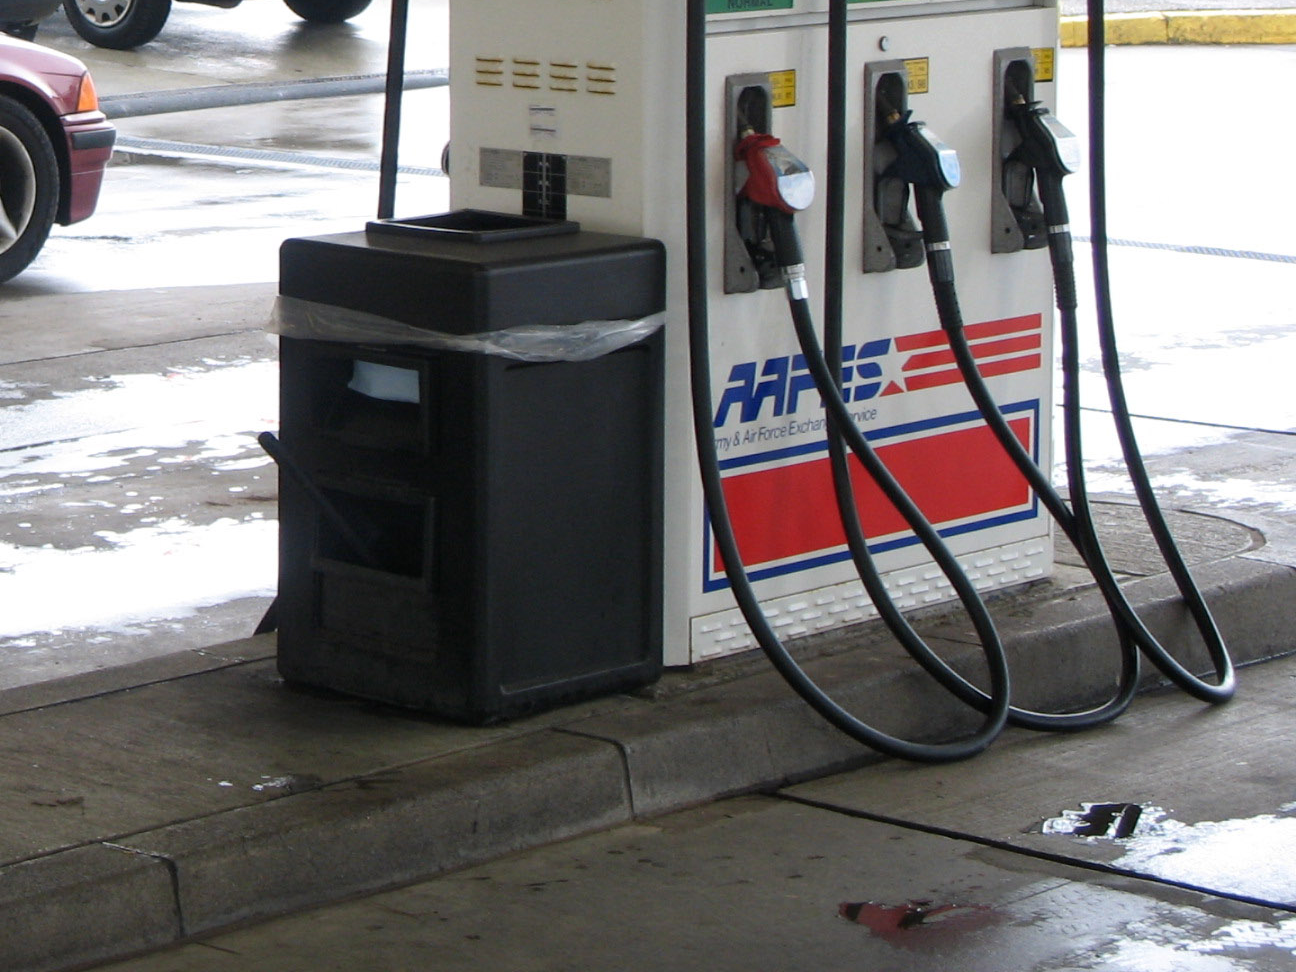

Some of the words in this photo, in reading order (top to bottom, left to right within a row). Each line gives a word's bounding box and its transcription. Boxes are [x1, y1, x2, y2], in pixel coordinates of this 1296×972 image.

[713, 337, 892, 428] AAFES
[715, 436, 733, 452] rmy
[733, 431, 741, 447] &
[742, 429, 757, 446] Air
[757, 424, 788, 442] Force
[789, 416, 827, 437] Exchan
[849, 405, 878, 424] rvice
